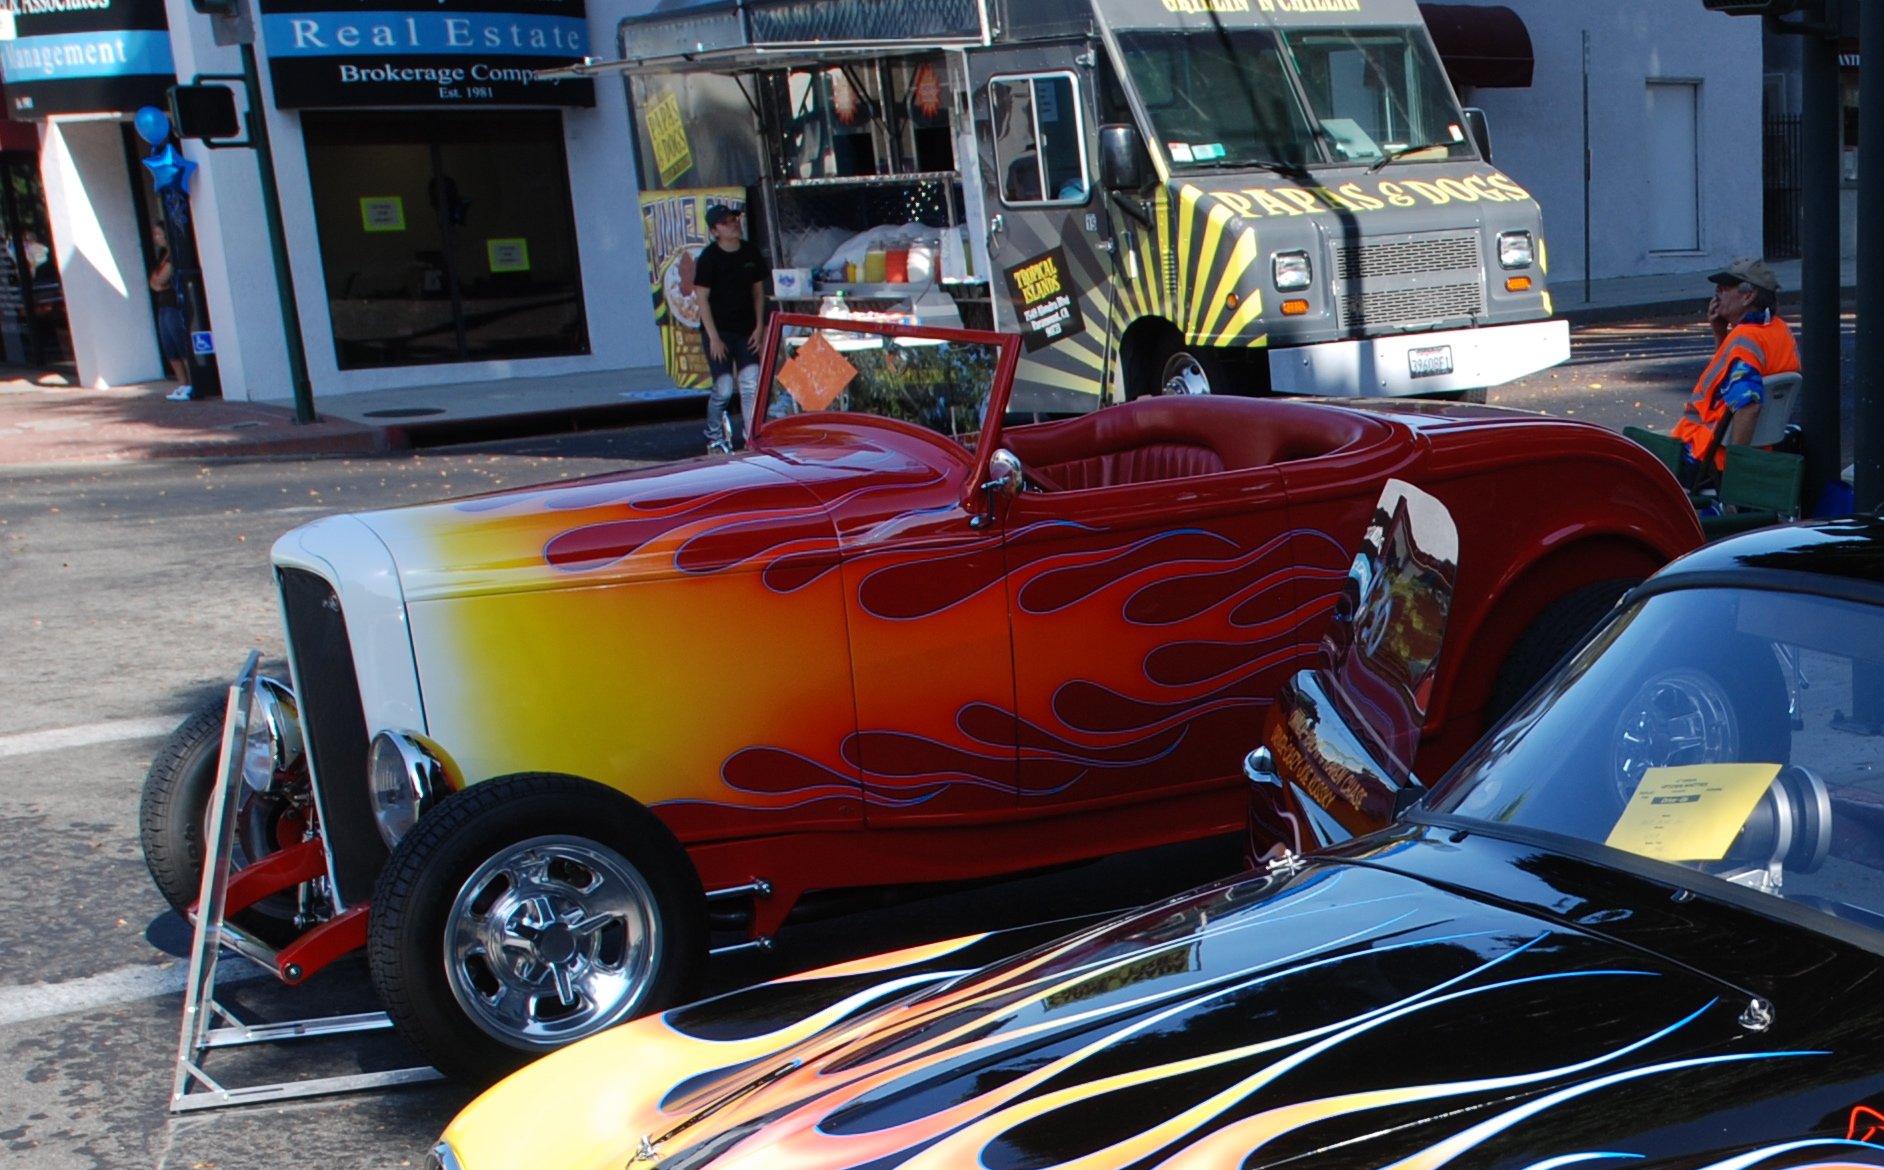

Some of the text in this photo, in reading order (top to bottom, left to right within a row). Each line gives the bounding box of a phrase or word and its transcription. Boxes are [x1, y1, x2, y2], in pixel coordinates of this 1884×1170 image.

[290, 17, 580, 50] Real Estate
[339, 63, 562, 86] Brokerage Comp
[466, 87, 493, 99] 1981
[1208, 173, 1532, 219] PAPAS & DOGS
[1013, 257, 1058, 289] TROPICAL
[1022, 274, 1061, 305] ISLANDS
